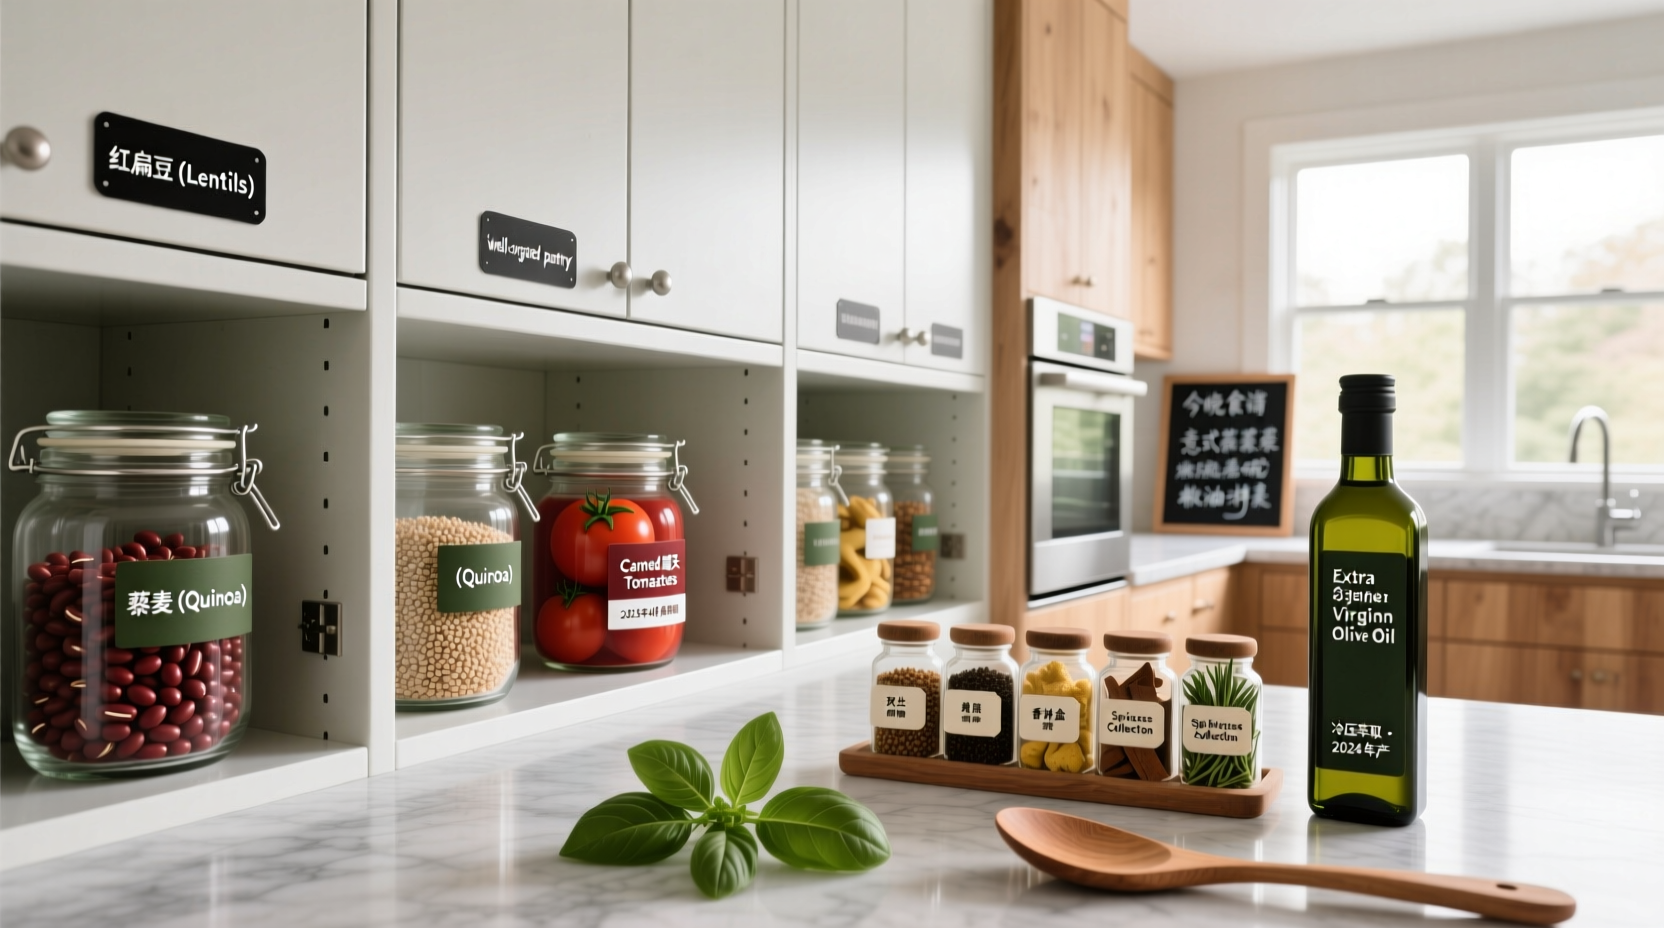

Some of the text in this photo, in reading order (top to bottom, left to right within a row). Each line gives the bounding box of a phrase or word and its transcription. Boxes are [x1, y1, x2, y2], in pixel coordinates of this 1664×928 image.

[109, 145, 255, 199] 红扁豆 (Lentils)
[1333, 568, 1375, 585] Extra
[178, 583, 247, 614] (Quinoa)
[1332, 626, 1395, 644] Olive Oil
